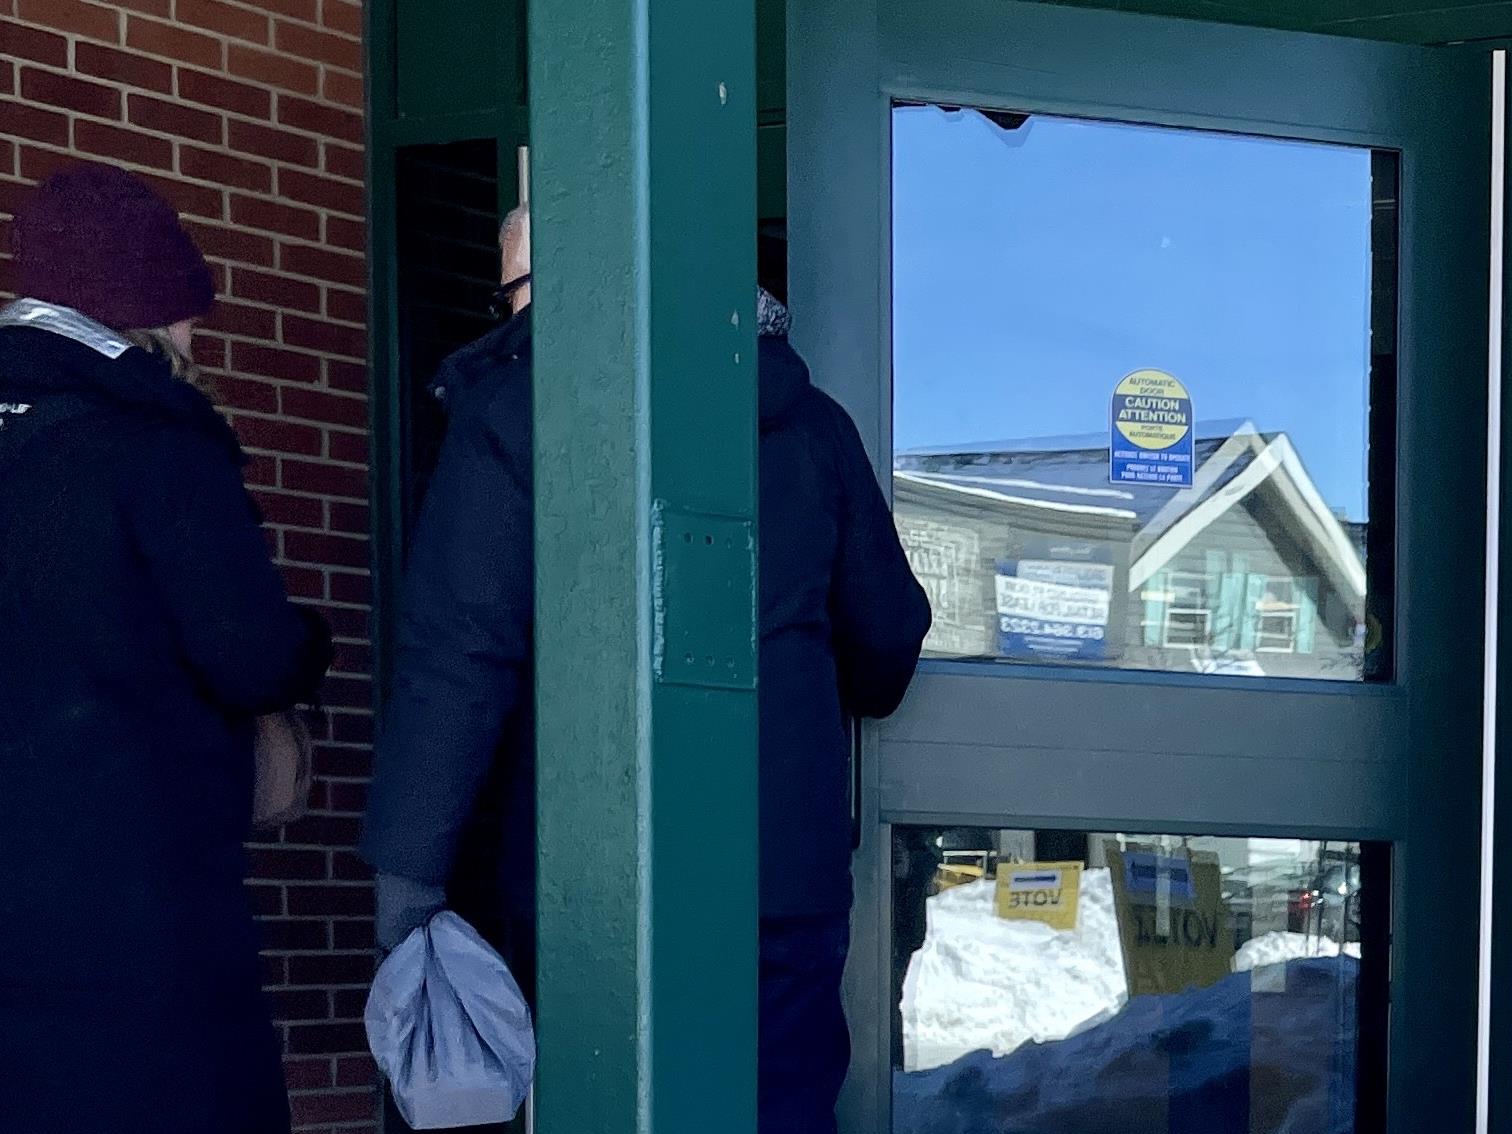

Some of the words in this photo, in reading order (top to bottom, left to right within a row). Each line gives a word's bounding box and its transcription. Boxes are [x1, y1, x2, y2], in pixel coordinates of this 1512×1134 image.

[1129, 378, 1175, 388] AUTOMATIC
[1125, 396, 1180, 411] CAUTION
[1119, 408, 1186, 423] ATTENTION
